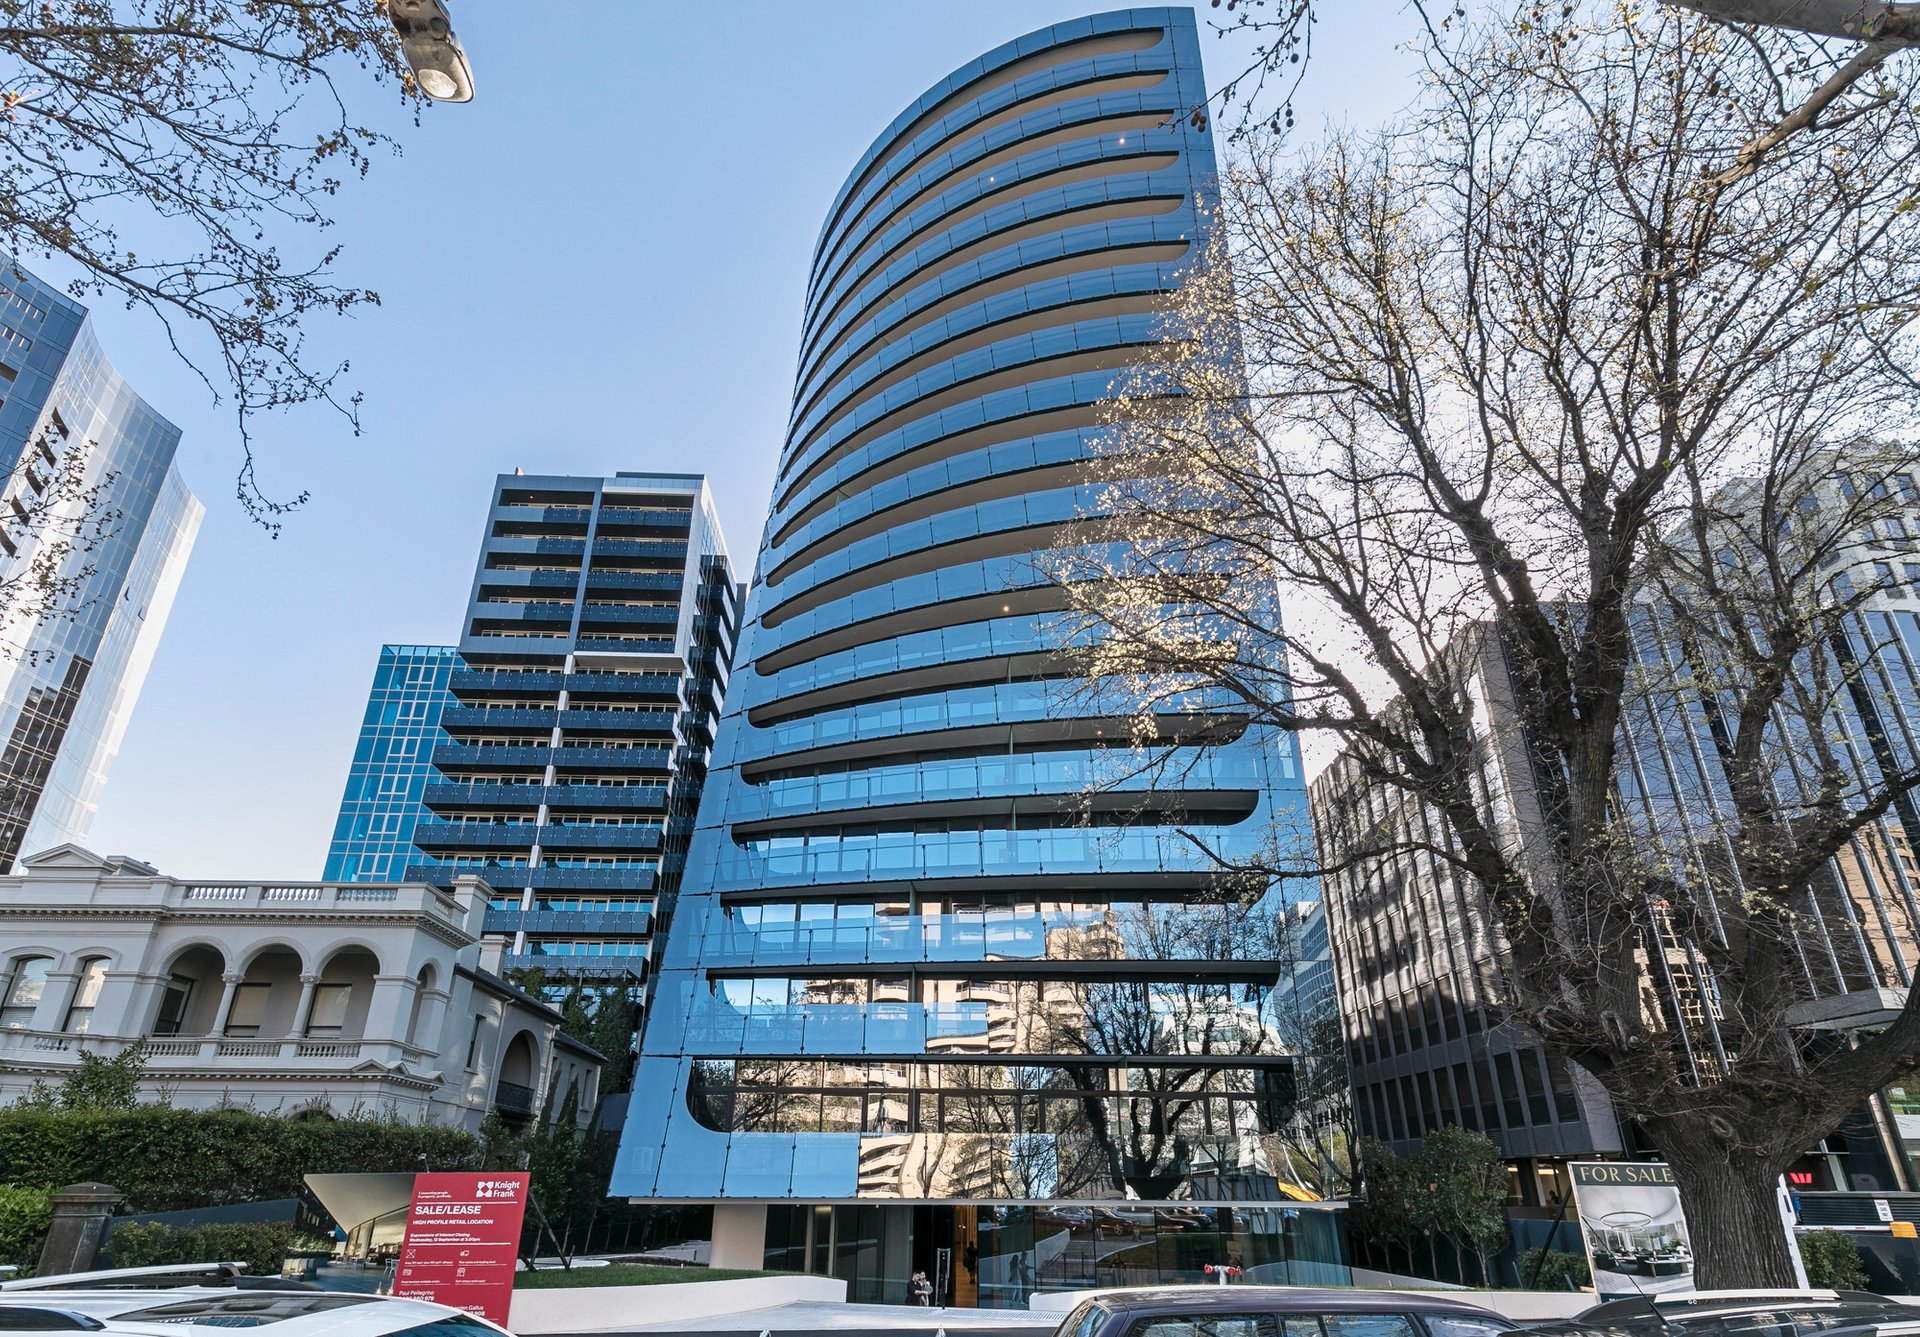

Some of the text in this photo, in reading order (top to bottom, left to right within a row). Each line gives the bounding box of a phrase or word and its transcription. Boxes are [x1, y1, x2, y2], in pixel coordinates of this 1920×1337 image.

[1580, 1167, 1675, 1182] FOR SALE
[494, 1181, 520, 1190] Knight
[493, 1190, 515, 1198] Frank
[415, 1205, 482, 1215] SALE/LEASE
